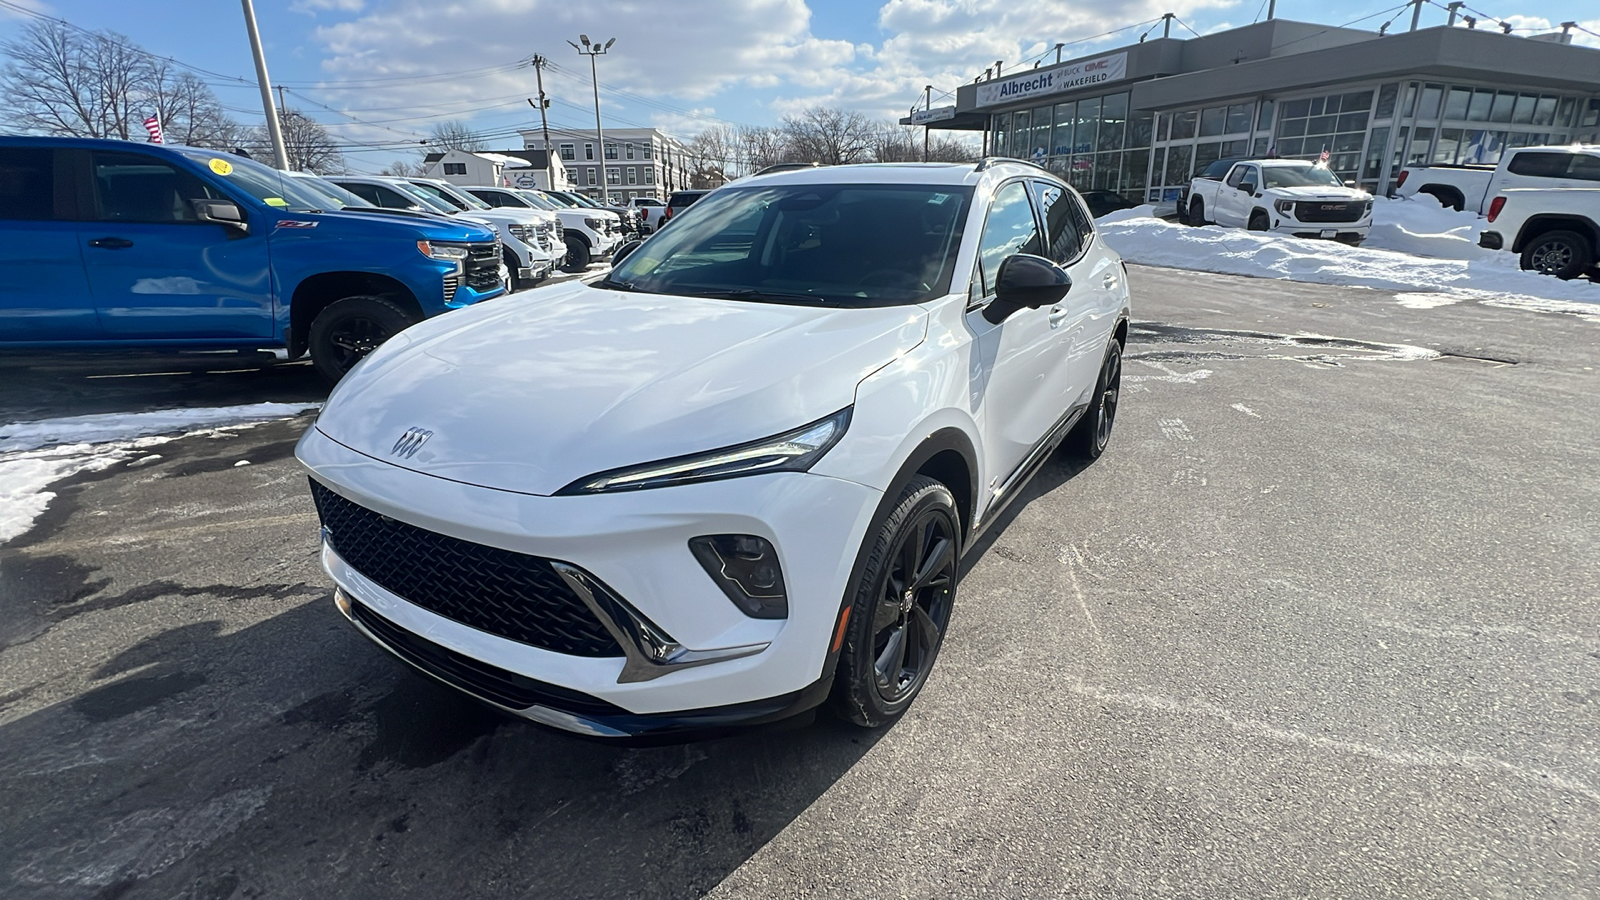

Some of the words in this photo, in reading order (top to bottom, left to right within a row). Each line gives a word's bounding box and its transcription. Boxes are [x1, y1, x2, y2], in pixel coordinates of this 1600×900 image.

[1064, 67, 1080, 77] BUICK
[1085, 60, 1109, 72] GMC
[1000, 73, 1053, 97] Albrecht
[1063, 73, 1107, 89] WAKEFIELD
